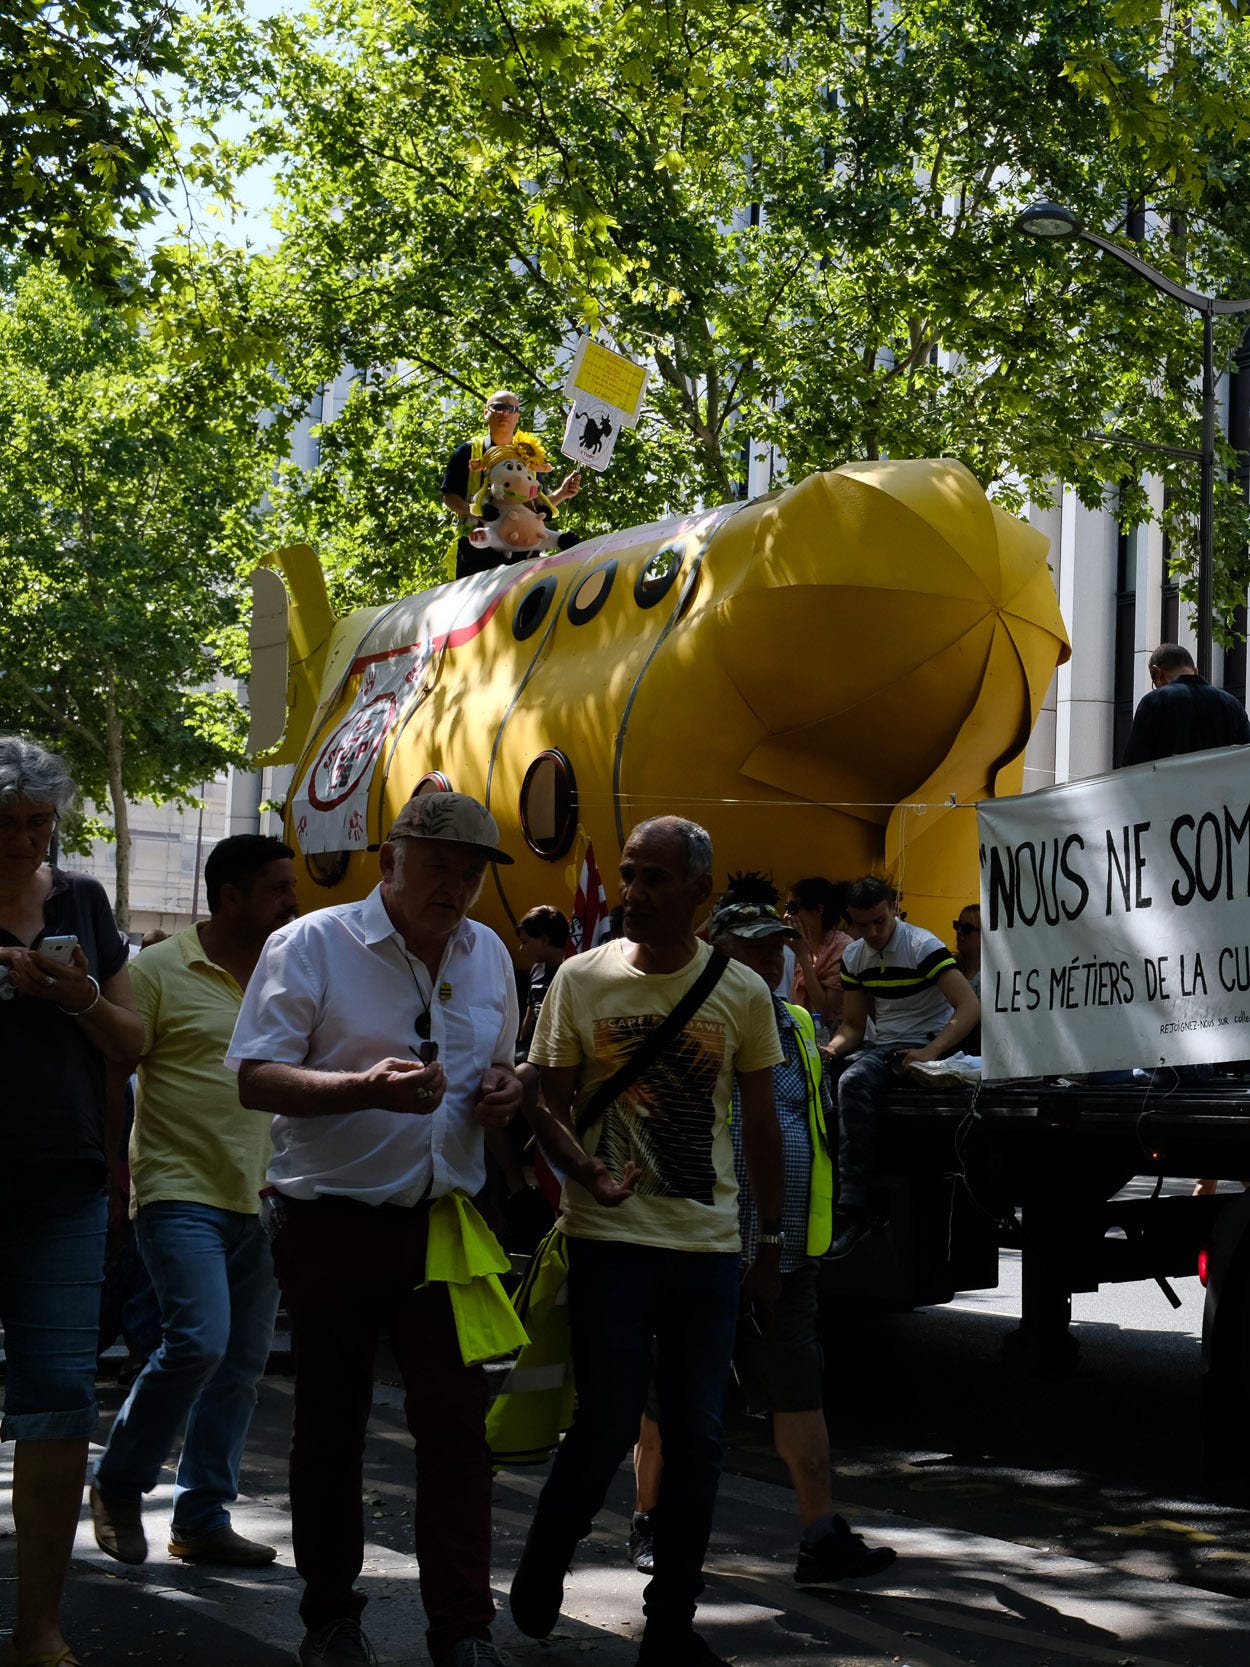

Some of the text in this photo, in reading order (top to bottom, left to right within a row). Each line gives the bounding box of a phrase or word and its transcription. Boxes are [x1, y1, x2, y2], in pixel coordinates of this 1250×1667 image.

[1106, 822, 1153, 916] NE
[994, 969, 1041, 1013] LES
[1048, 953, 1135, 1010] MÉTIERS
[1144, 956, 1171, 1002] DE
[1180, 952, 1209, 997] LA
